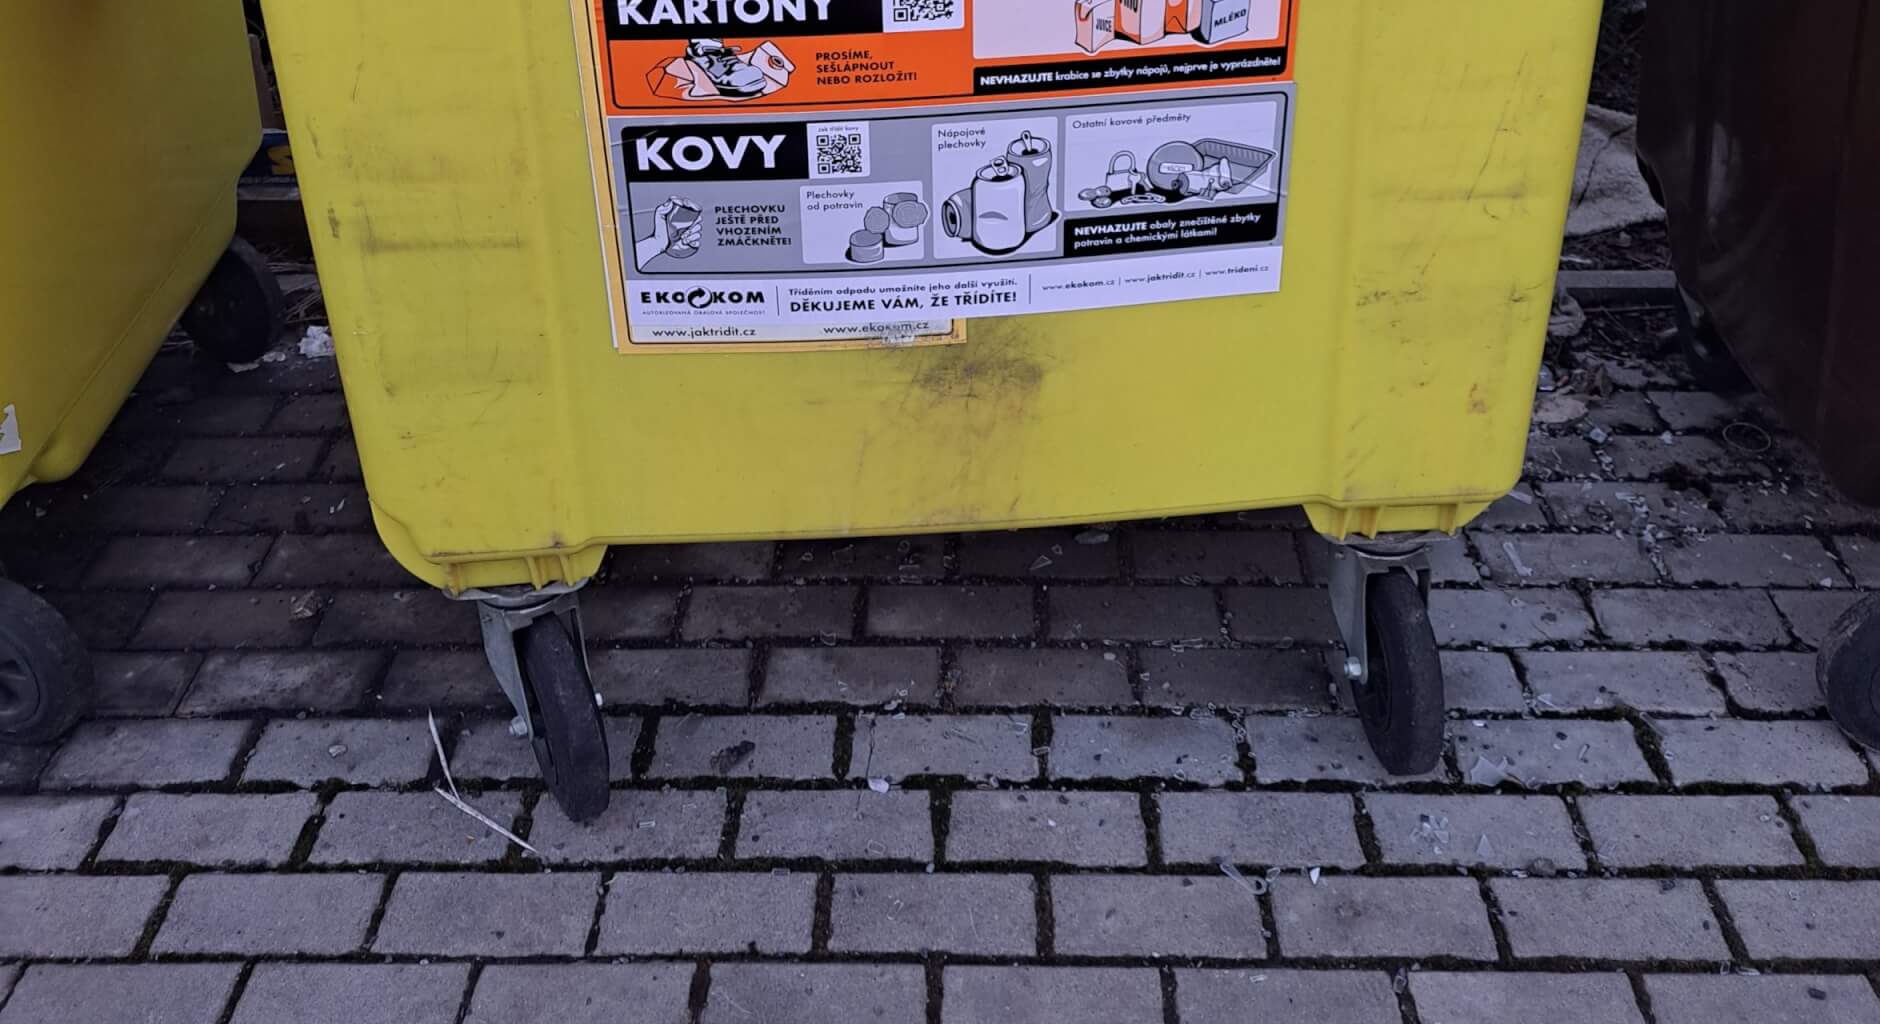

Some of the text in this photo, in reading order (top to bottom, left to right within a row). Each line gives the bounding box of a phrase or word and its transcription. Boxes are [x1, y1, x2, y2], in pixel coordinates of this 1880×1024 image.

[1214, 8, 1247, 27] MLÉKO
[1096, 18, 1112, 32] JUICE
[816, 48, 872, 62] PROSÍME,
[816, 60, 894, 74] SEŠLÁPNOUT
[980, 55, 1280, 86] NEVHAZUJTE krabice se zbytky nápojů, nejprve je vyprázdněte!
[817, 70, 917, 85] NEBO ROZLOŽIT!
[1073, 113, 1191, 129] Ostatní kovové předměty
[938, 127, 986, 139] Nápojové
[938, 138, 986, 151] plechovky
[635, 134, 786, 171] KOVY
[806, 190, 855, 201] Plechovky
[714, 204, 785, 214] PLECHOVKU
[807, 200, 863, 212] od potravin
[715, 213, 778, 225] JEŠTĚ PŘED
[1074, 212, 1261, 236] NEVHAZUJTE obaly znečištěné zbytky
[716, 224, 782, 236] VHOZENÍM
[717, 234, 792, 246] ZMÁČKNĚTE!
[1074, 227, 1217, 250] potravin a chemickými látkami!
[1205, 264, 1269, 276] www.trideni.cz
[1125, 271, 1196, 283] www.jaktridit.cz
[789, 288, 832, 296] Tříděním
[836, 287, 875, 296] odpadu
[929, 283, 950, 293] jeho
[954, 280, 978, 290] další
[1042, 279, 1115, 290] www.ekokom.cz
[790, 292, 1017, 313] DĚKUJEME VÁM, ŽE TŘÍDÍTE!
[652, 326, 757, 339] www.jaktridit.cz
